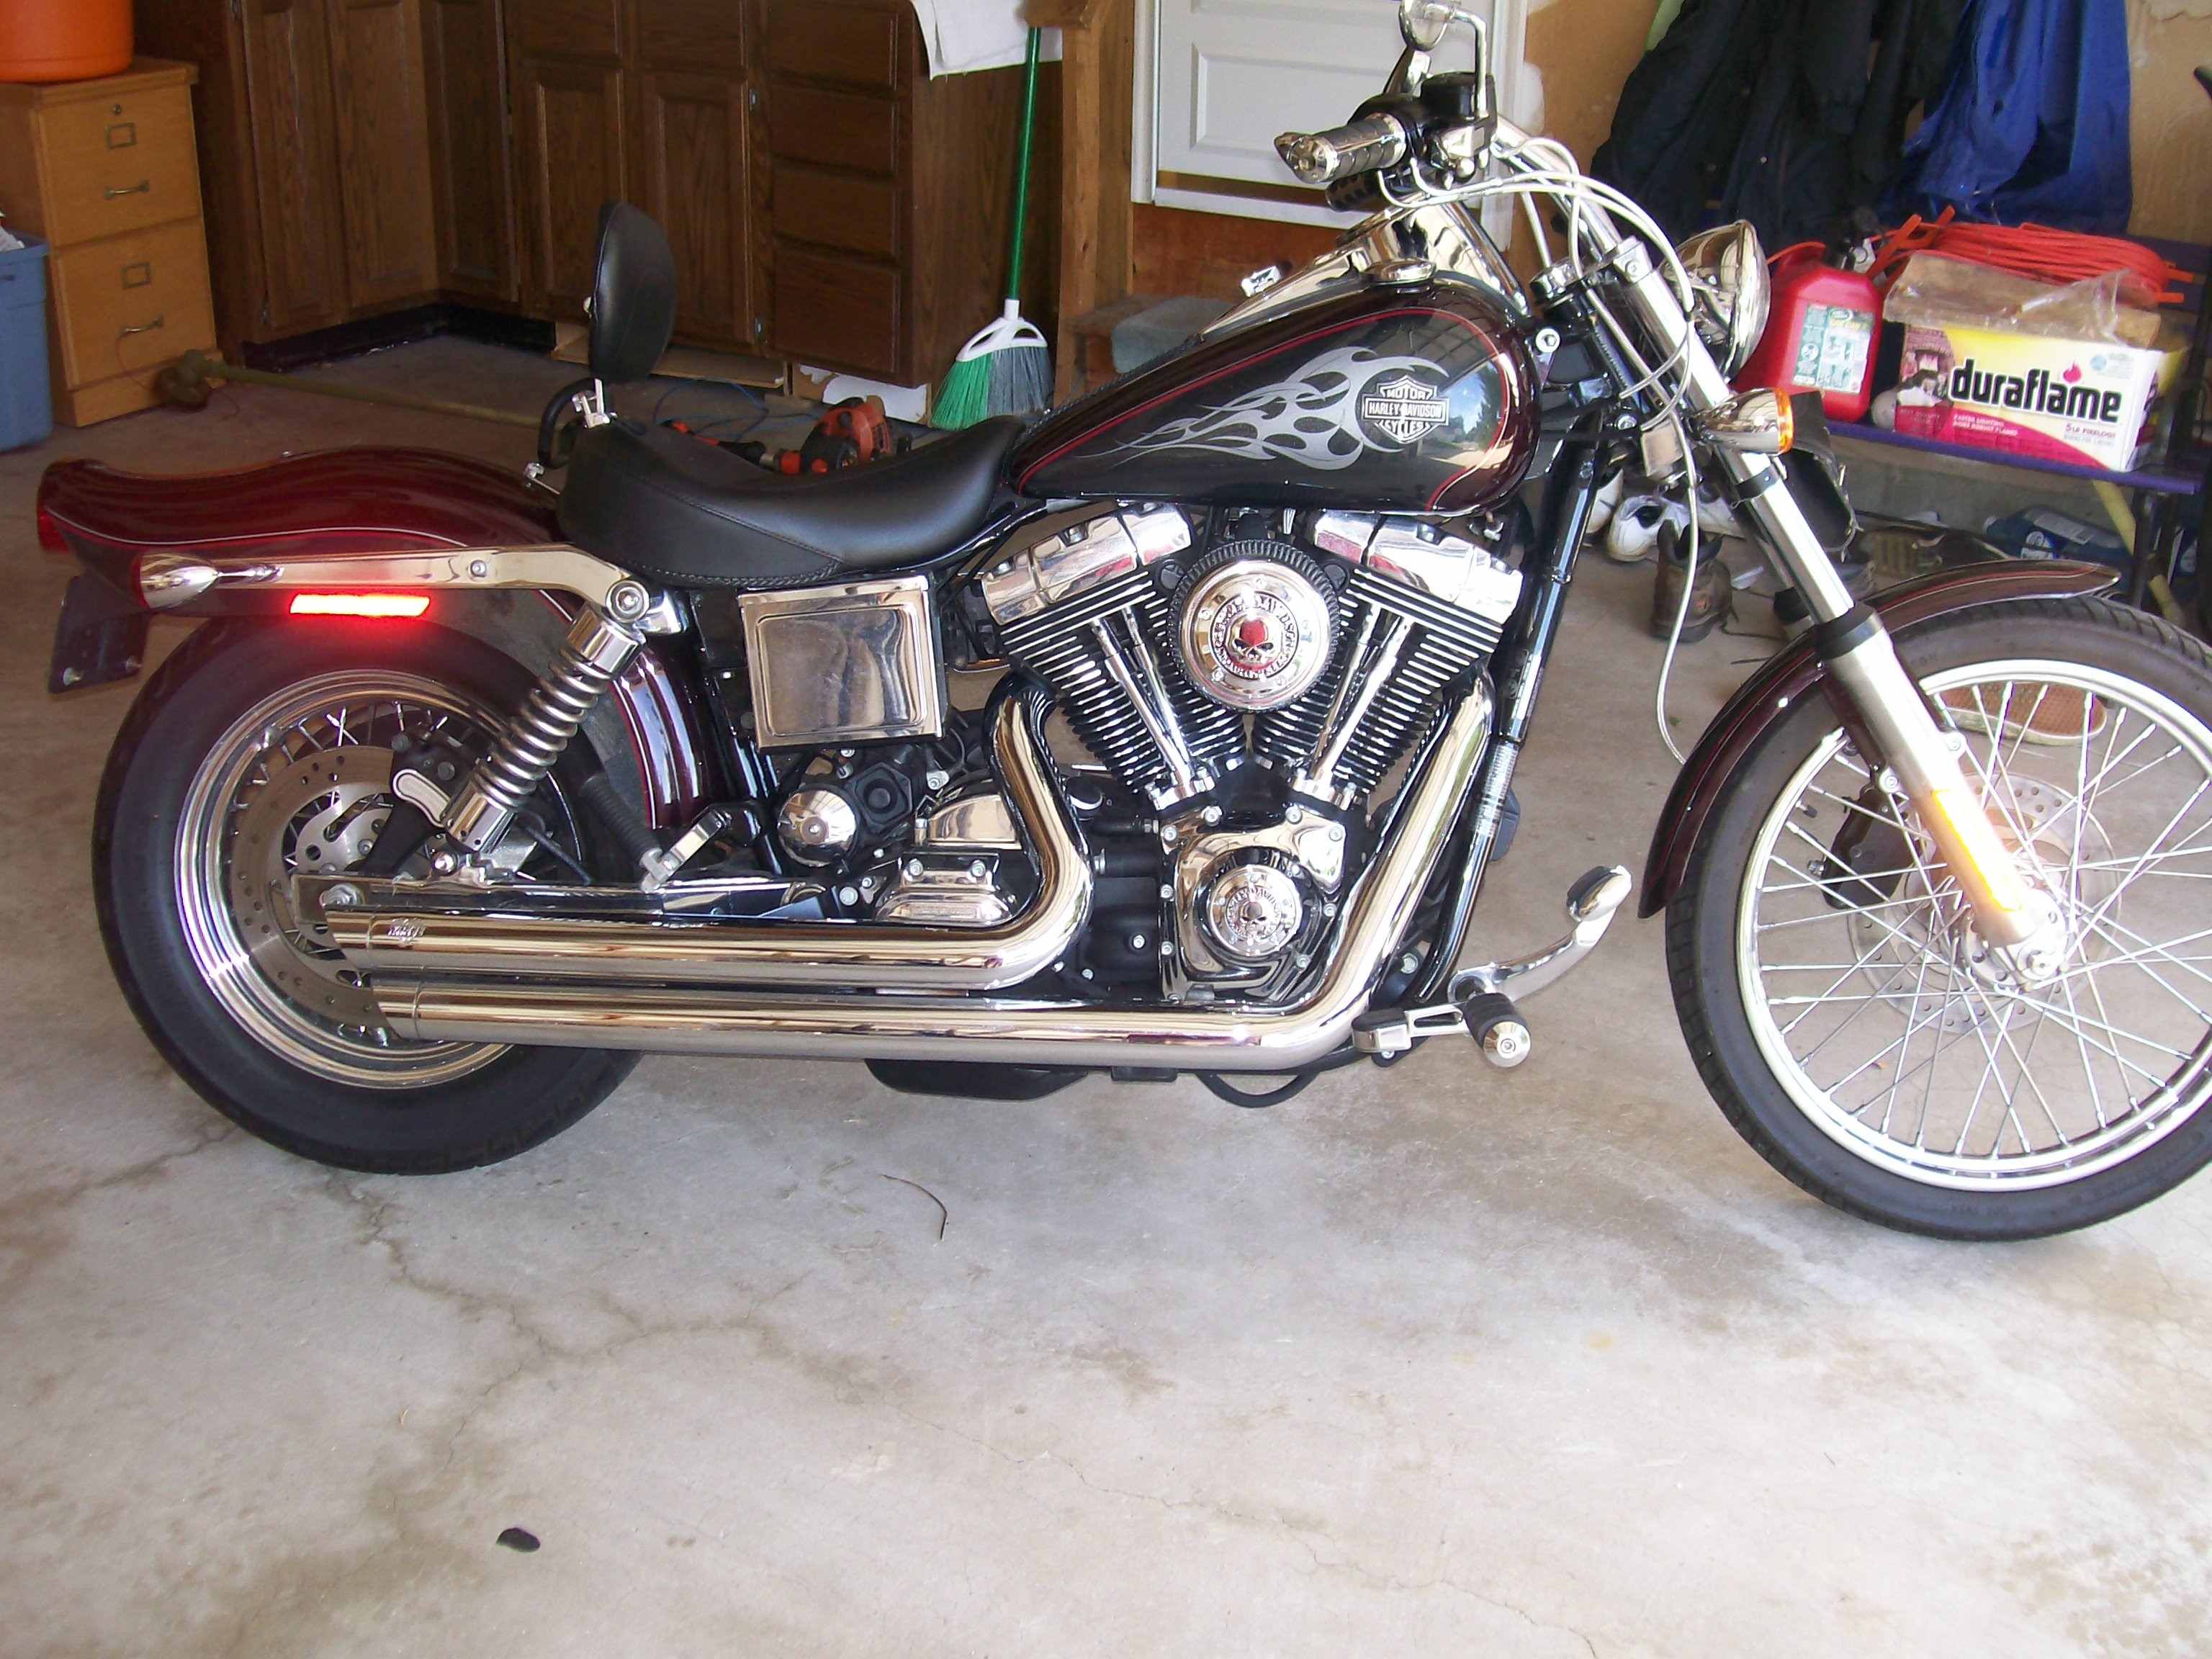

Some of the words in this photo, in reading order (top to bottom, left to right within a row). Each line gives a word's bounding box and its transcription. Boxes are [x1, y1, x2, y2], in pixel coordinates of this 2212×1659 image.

[1387, 384, 1426, 400] MOTOR
[1951, 359, 2122, 423] duraflame
[1384, 420, 1424, 437] CYCLES
